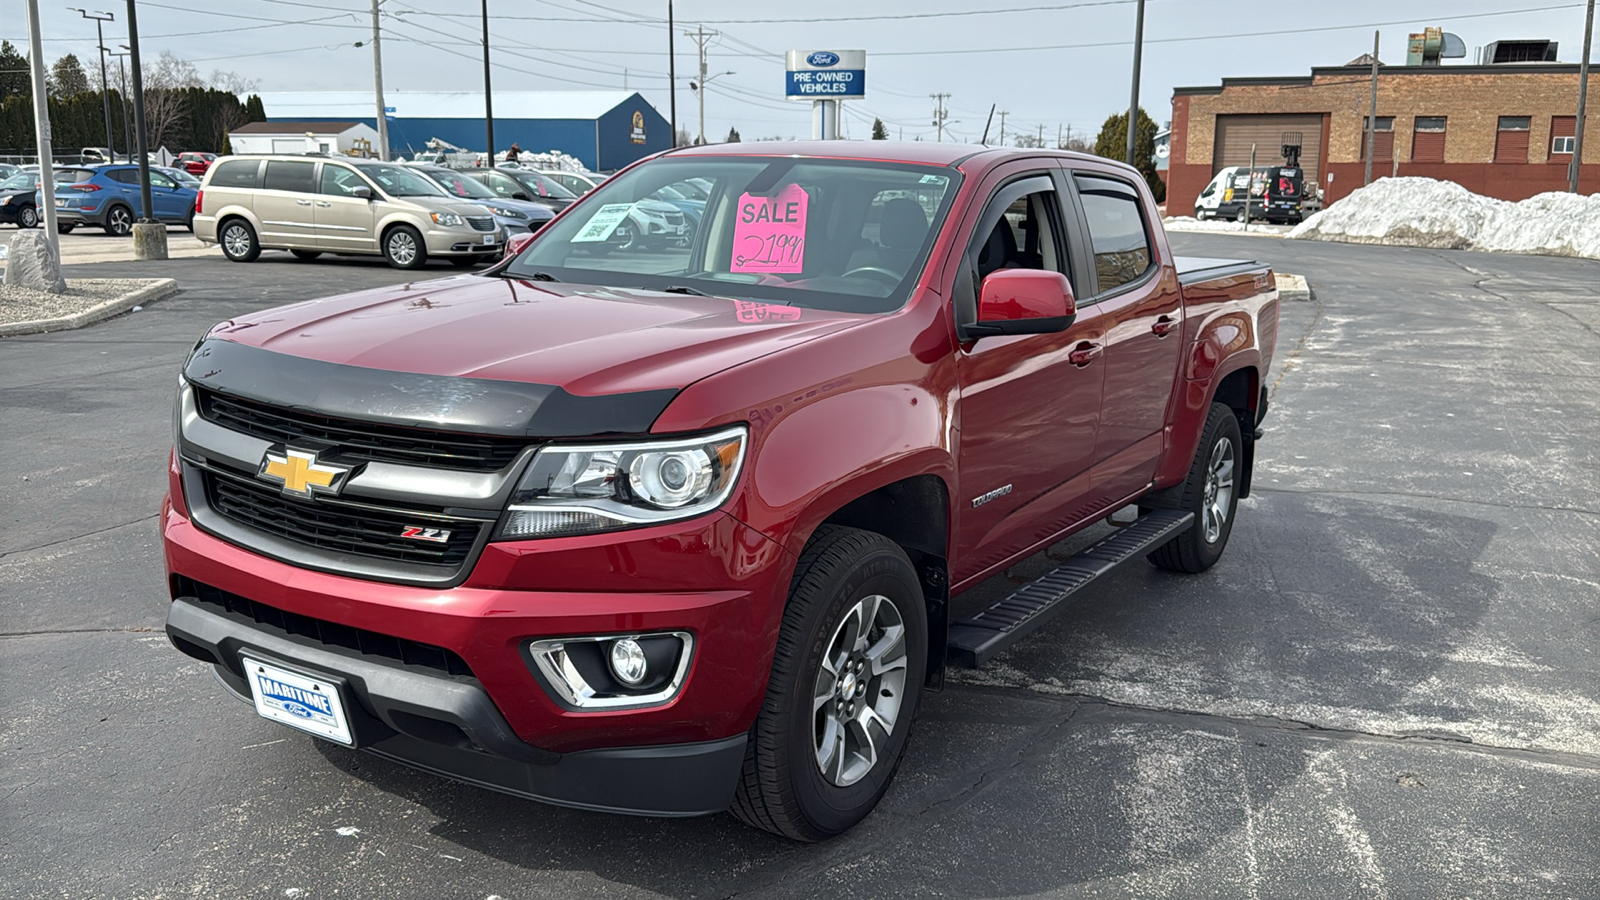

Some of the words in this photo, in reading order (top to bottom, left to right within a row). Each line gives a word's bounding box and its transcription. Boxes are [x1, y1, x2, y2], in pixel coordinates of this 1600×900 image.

[812, 54, 832, 64] Ford
[793, 72, 853, 83] PRE-OWNED
[799, 83, 847, 93] VEHICLES
[741, 202, 799, 223] SALE
[401, 525, 451, 543] Z71
[258, 675, 333, 716] MARITIME
[289, 702, 309, 717] Ford
